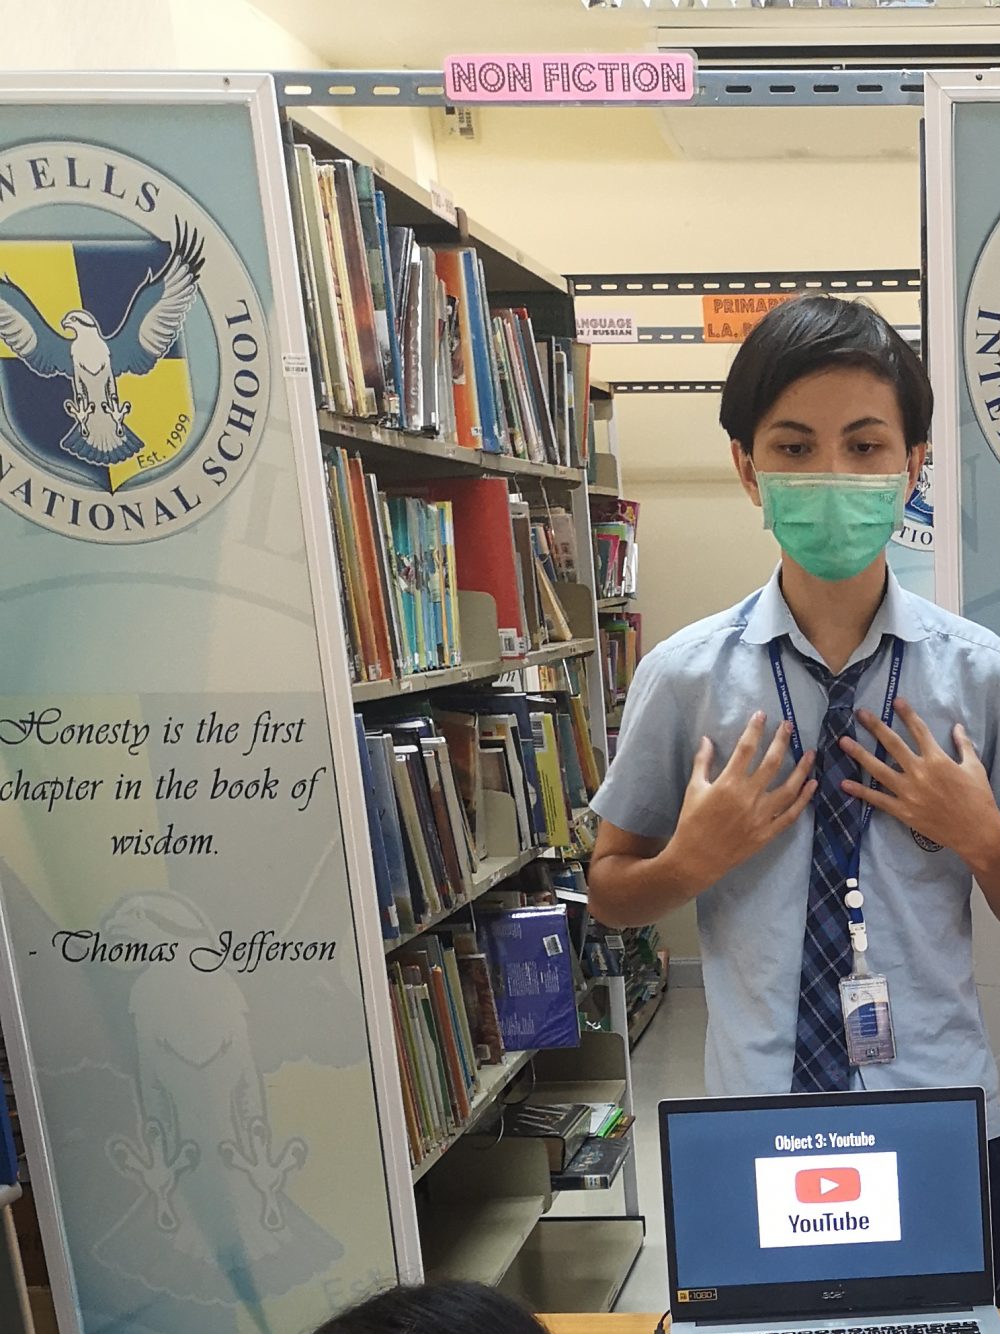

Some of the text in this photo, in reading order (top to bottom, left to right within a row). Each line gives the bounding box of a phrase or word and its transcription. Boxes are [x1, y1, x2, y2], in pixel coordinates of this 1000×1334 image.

[451, 62, 686, 93] NON FICTION
[202, 298, 261, 487] SCHOOL
[137, 413, 190, 469] Est. 1999
[0, 707, 306, 756] Honesty is the first
[0, 766, 327, 813] chapter in the book of
[111, 823, 219, 856] wisdom.
[52, 930, 179, 963] Thomas
[189, 930, 337, 974] Jefferson
[775, 1131, 876, 1152] Object 3: Youtube
[788, 1211, 870, 1234] YouTube
